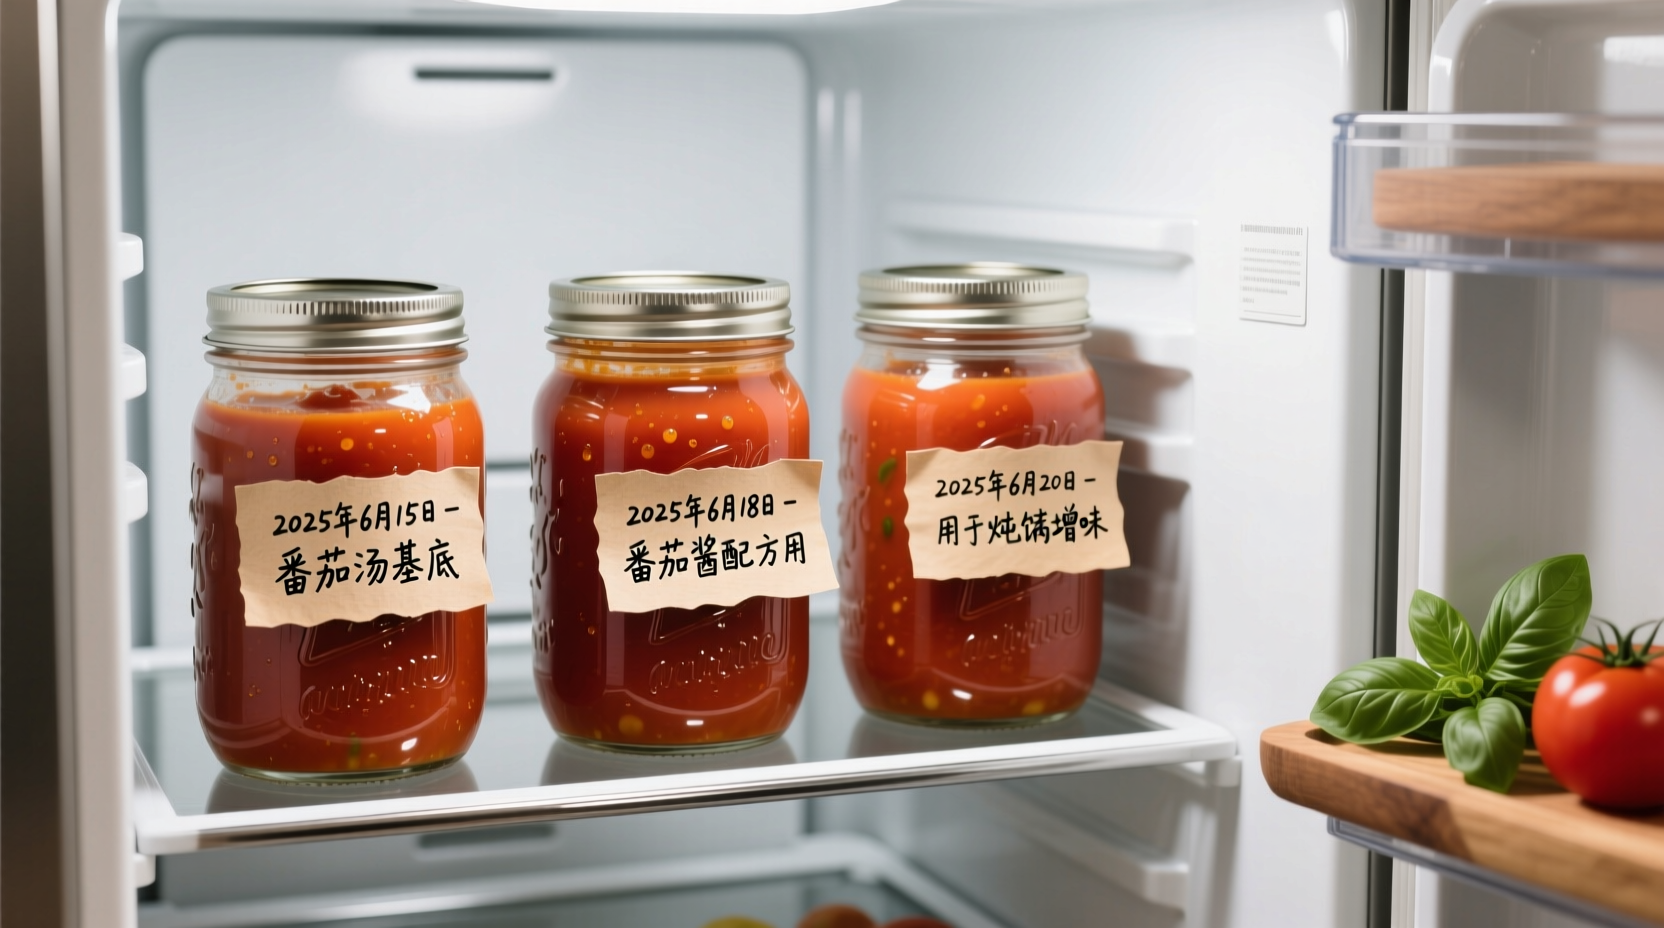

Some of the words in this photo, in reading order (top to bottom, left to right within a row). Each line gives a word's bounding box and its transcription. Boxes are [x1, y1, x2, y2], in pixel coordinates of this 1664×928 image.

[274, 538, 460, 596] 番茄汤基底
[623, 531, 807, 584] 番茄酱配方用
